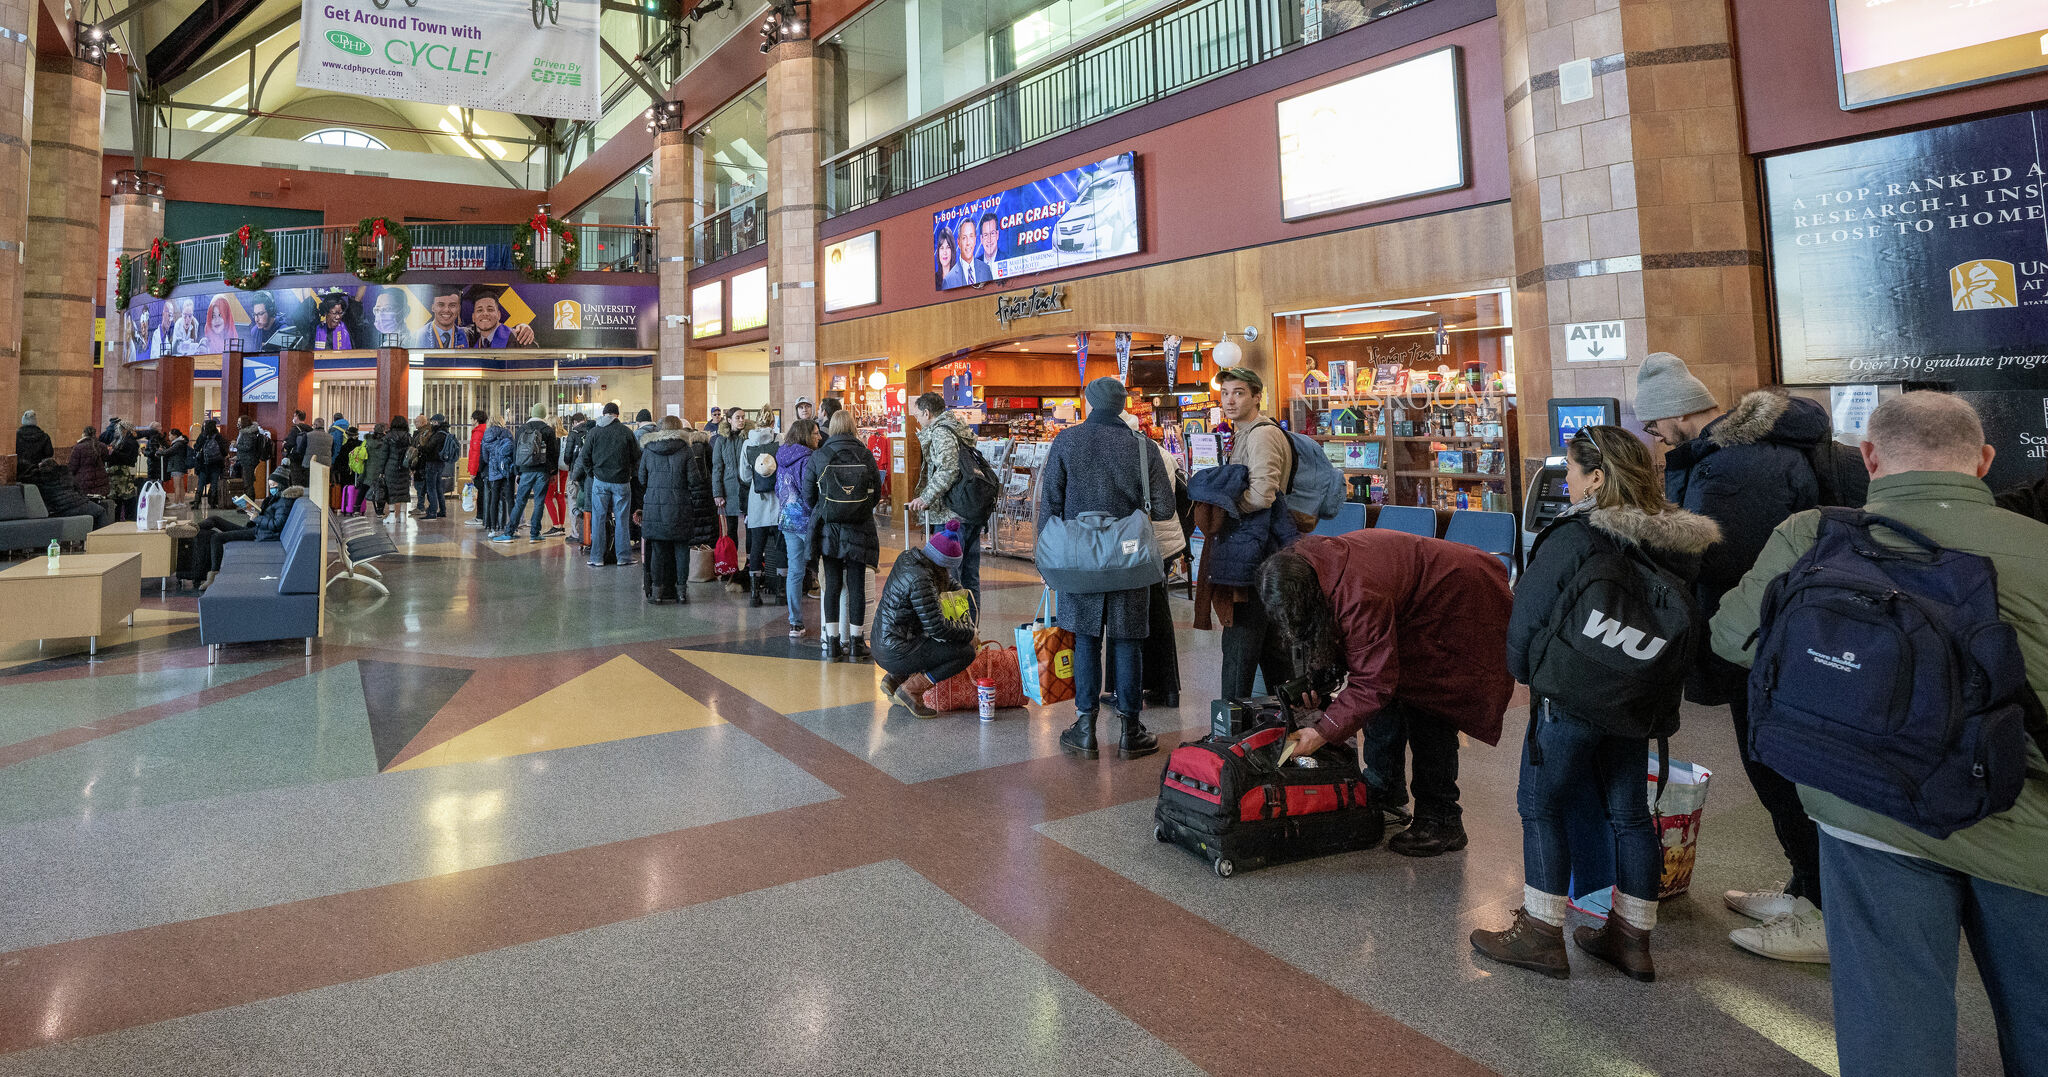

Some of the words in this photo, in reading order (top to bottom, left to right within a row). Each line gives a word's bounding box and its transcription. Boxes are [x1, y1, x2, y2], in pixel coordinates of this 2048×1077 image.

[324, 5, 350, 22] Get
[354, 12, 407, 30] Around
[411, 17, 447, 35] Town
[451, 24, 482, 40] with
[330, 34, 366, 52] CDPHP
[384, 39, 492, 76] CYCLE!
[533, 57, 565, 70] Driven
[567, 62, 582, 72] By
[322, 60, 403, 77] www.cdphpcycle.com
[1793, 198, 1806, 210] A
[1816, 167, 2012, 206] TOP-RANKED
[934, 196, 1001, 224] 1-800-LAW-1010
[1000, 214, 1023, 230] CAR
[1024, 200, 1066, 223] CRASH
[1795, 193, 1970, 229] RESEARCH-1
[1795, 225, 1883, 247] CLOSE
[1893, 219, 1934, 235] TO
[1949, 205, 2045, 230] HOME
[1017, 229, 1050, 247] PROS
[410, 249, 445, 268] TALK
[2022, 279, 2044, 291] AT
[583, 304, 636, 313] UNIVERSITY
[592, 313, 636, 325] ALBANY
[1570, 323, 1622, 340] ATM
[1850, 357, 1888, 371] Over
[1891, 356, 1921, 369] 150
[1923, 354, 1994, 373] graduate
[1291, 381, 1498, 411] NEWSROOM
[1560, 415, 1604, 428] ATM
[1582, 609, 1667, 660] WU
[1807, 648, 1831, 660] Secure
